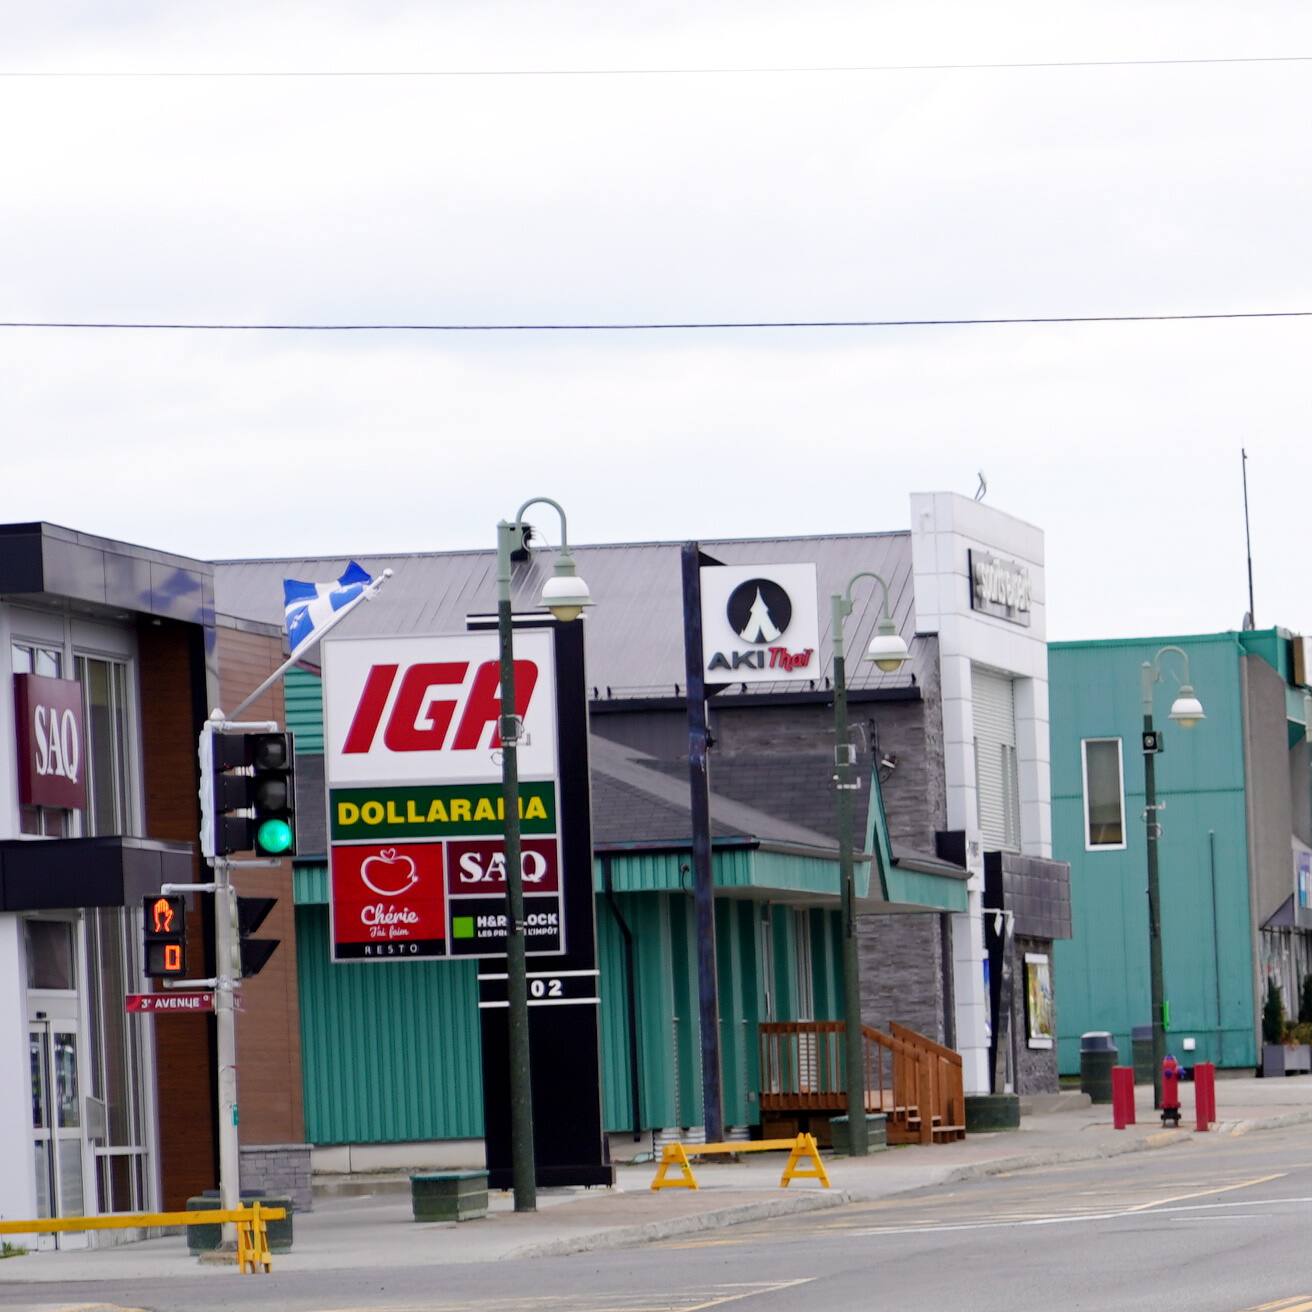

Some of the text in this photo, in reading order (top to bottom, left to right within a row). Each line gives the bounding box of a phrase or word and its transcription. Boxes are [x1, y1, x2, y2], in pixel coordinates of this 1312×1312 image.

[708, 650, 765, 671] AKI
[341, 659, 539, 755] IGA
[34, 704, 78, 784] SAQ
[459, 850, 547, 883] SAQ
[361, 902, 419, 925] Chérie
[477, 915, 507, 928] H&R
[165, 945, 181, 971] 0
[364, 943, 418, 956] RESTO
[155, 997, 200, 1009] AVENUE
